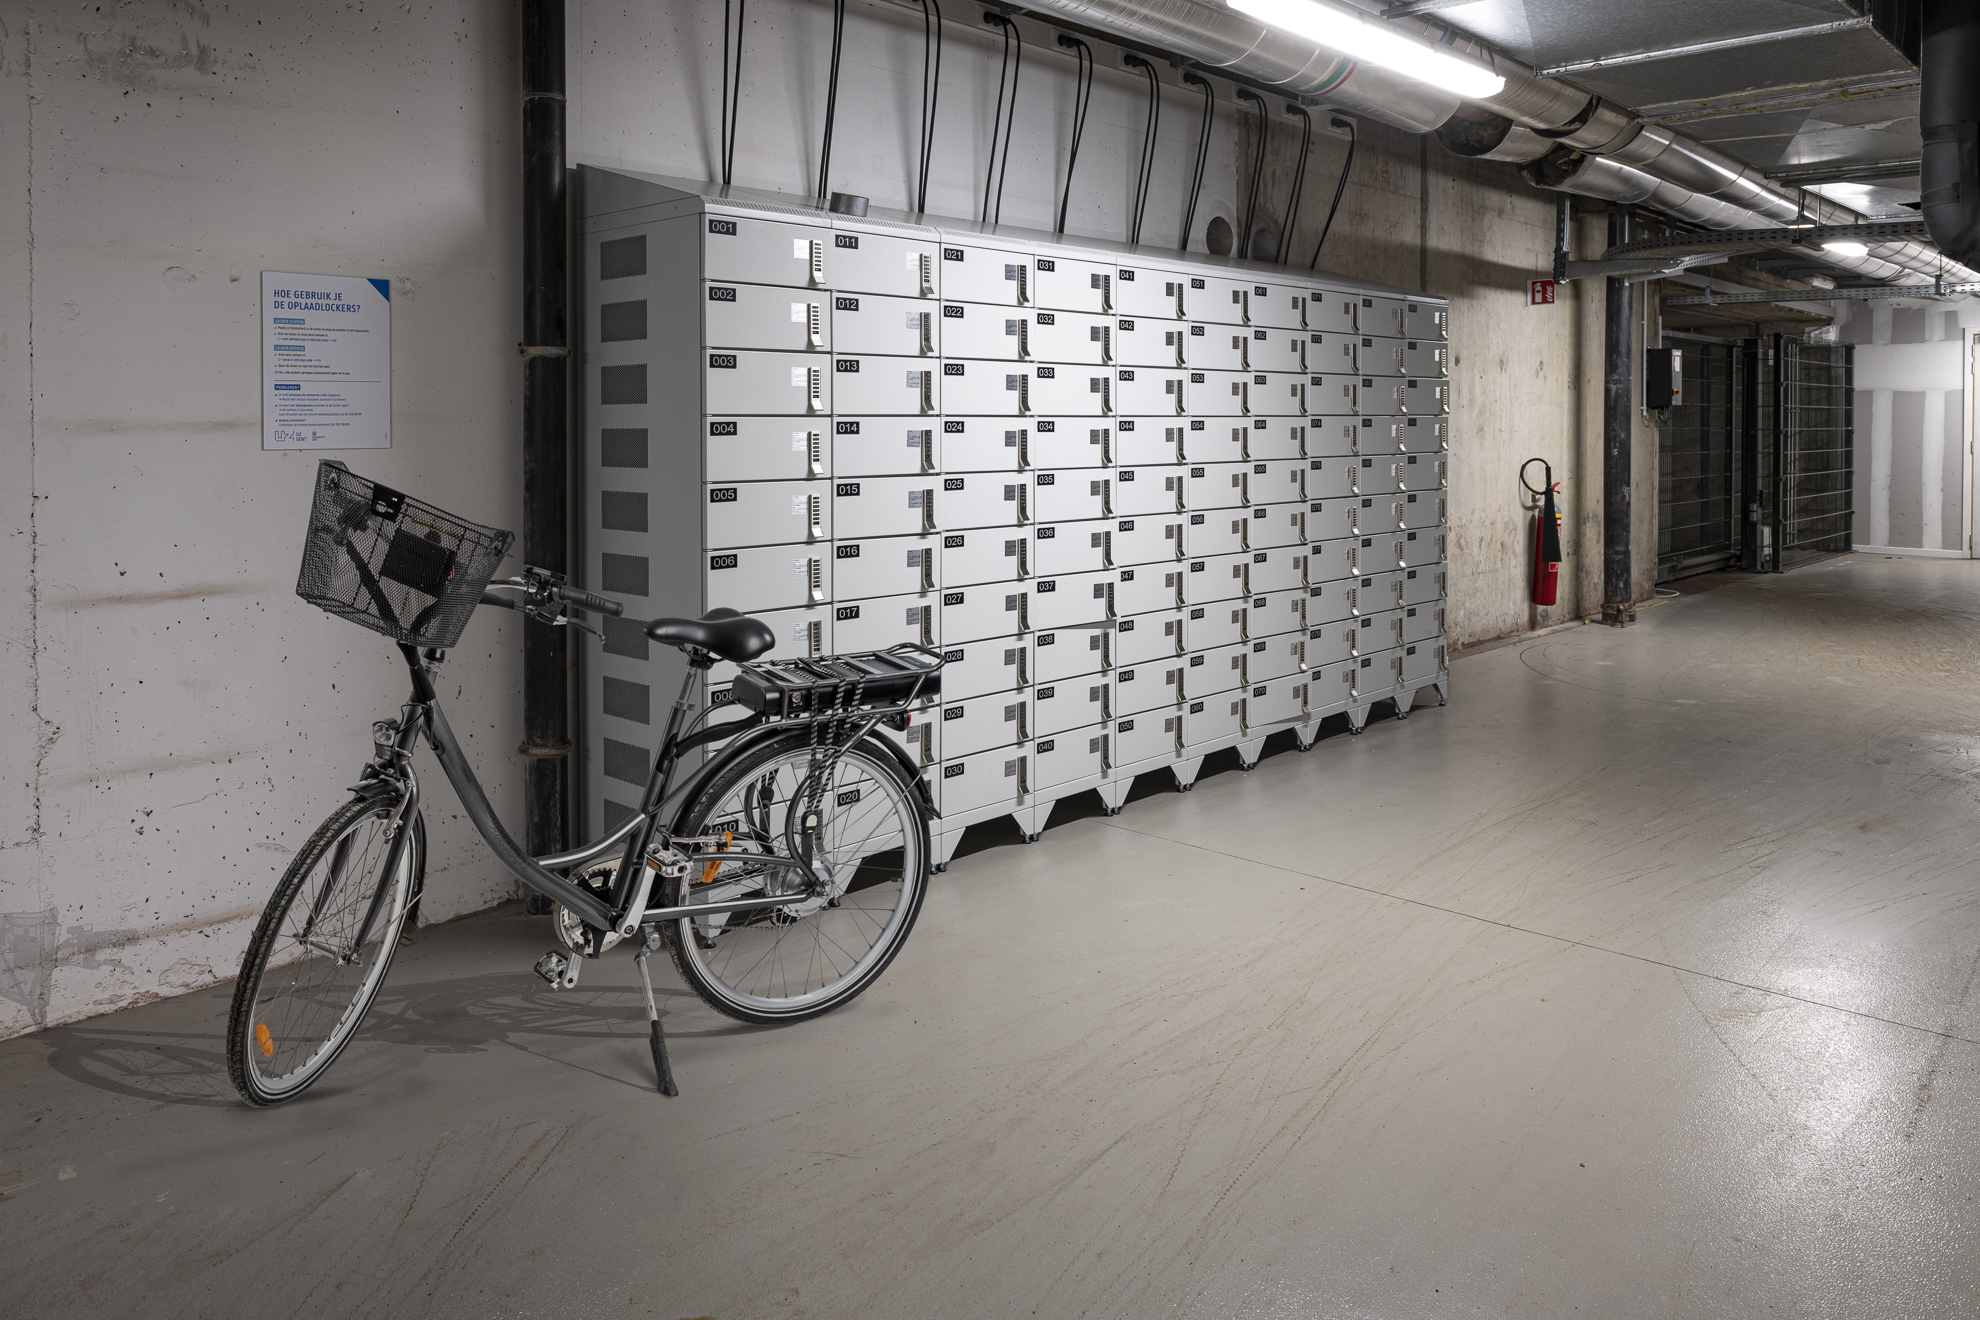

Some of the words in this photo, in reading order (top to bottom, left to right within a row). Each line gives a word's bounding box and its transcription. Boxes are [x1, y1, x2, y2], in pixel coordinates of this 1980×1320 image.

[712, 221, 732, 233] 001
[838, 236, 855, 247] 011
[946, 250, 961, 259] 021
[1039, 261, 1053, 270] 031
[1120, 271, 1133, 279] 041
[1192, 280, 1203, 288] 051
[274, 289, 292, 299] HOE
[293, 290, 332, 301] GEBRUIK
[333, 292, 343, 301] JE
[712, 289, 734, 300] 002
[1255, 287, 1265, 295] 061
[274, 300, 285, 310] DE
[287, 301, 361, 313] OPLAADLOCKERS?
[838, 299, 857, 309] 012
[945, 307, 962, 316] 022
[1038, 314, 1053, 324] 032
[1120, 321, 1133, 329] 042
[1192, 327, 1204, 335] 052
[1255, 331, 1266, 339] 062
[712, 356, 734, 366] 003
[838, 361, 857, 371] 013
[946, 365, 963, 374] 023
[1038, 368, 1053, 377] 033
[1120, 372, 1133, 380] 043
[1192, 374, 1204, 382] 053
[713, 423, 734, 434] 004
[839, 423, 857, 433] 014
[946, 422, 962, 431] 024
[1039, 422, 1053, 431] 034
[1120, 422, 1133, 430] 044
[1192, 468, 1204, 477] 055
[1255, 465, 1266, 473] 065
[1038, 475, 1053, 484] 035
[1120, 472, 1133, 480] 045
[946, 479, 963, 489] 025
[713, 489, 735, 500] 005
[839, 484, 858, 495] 015
[1192, 515, 1204, 524] 056
[1120, 521, 1133, 530] 046
[1039, 528, 1054, 538] 036
[946, 536, 963, 546] 026
[839, 546, 858, 557] 016
[713, 556, 735, 568] 006
[1255, 554, 1266, 562] 067
[1192, 562, 1203, 571] 057
[1121, 571, 1133, 580] 047
[1039, 582, 1054, 591] 037
[946, 594, 962, 604] 027
[839, 607, 857, 618] 017
[1192, 609, 1203, 618] 058
[1120, 621, 1133, 631] 048
[1039, 635, 1053, 645] 038
[946, 651, 962, 661] 028
[1191, 656, 1203, 665] 059
[1120, 671, 1133, 681] 049
[1038, 688, 1053, 698] 039
[1254, 687, 1266, 696] 070
[1191, 703, 1203, 712] 060
[946, 708, 962, 719] 029
[1120, 721, 1133, 731] 050
[1038, 741, 1053, 752] 040
[946, 765, 963, 776] 030
[839, 791, 858, 805] 020
[714, 822, 737, 833] 010
